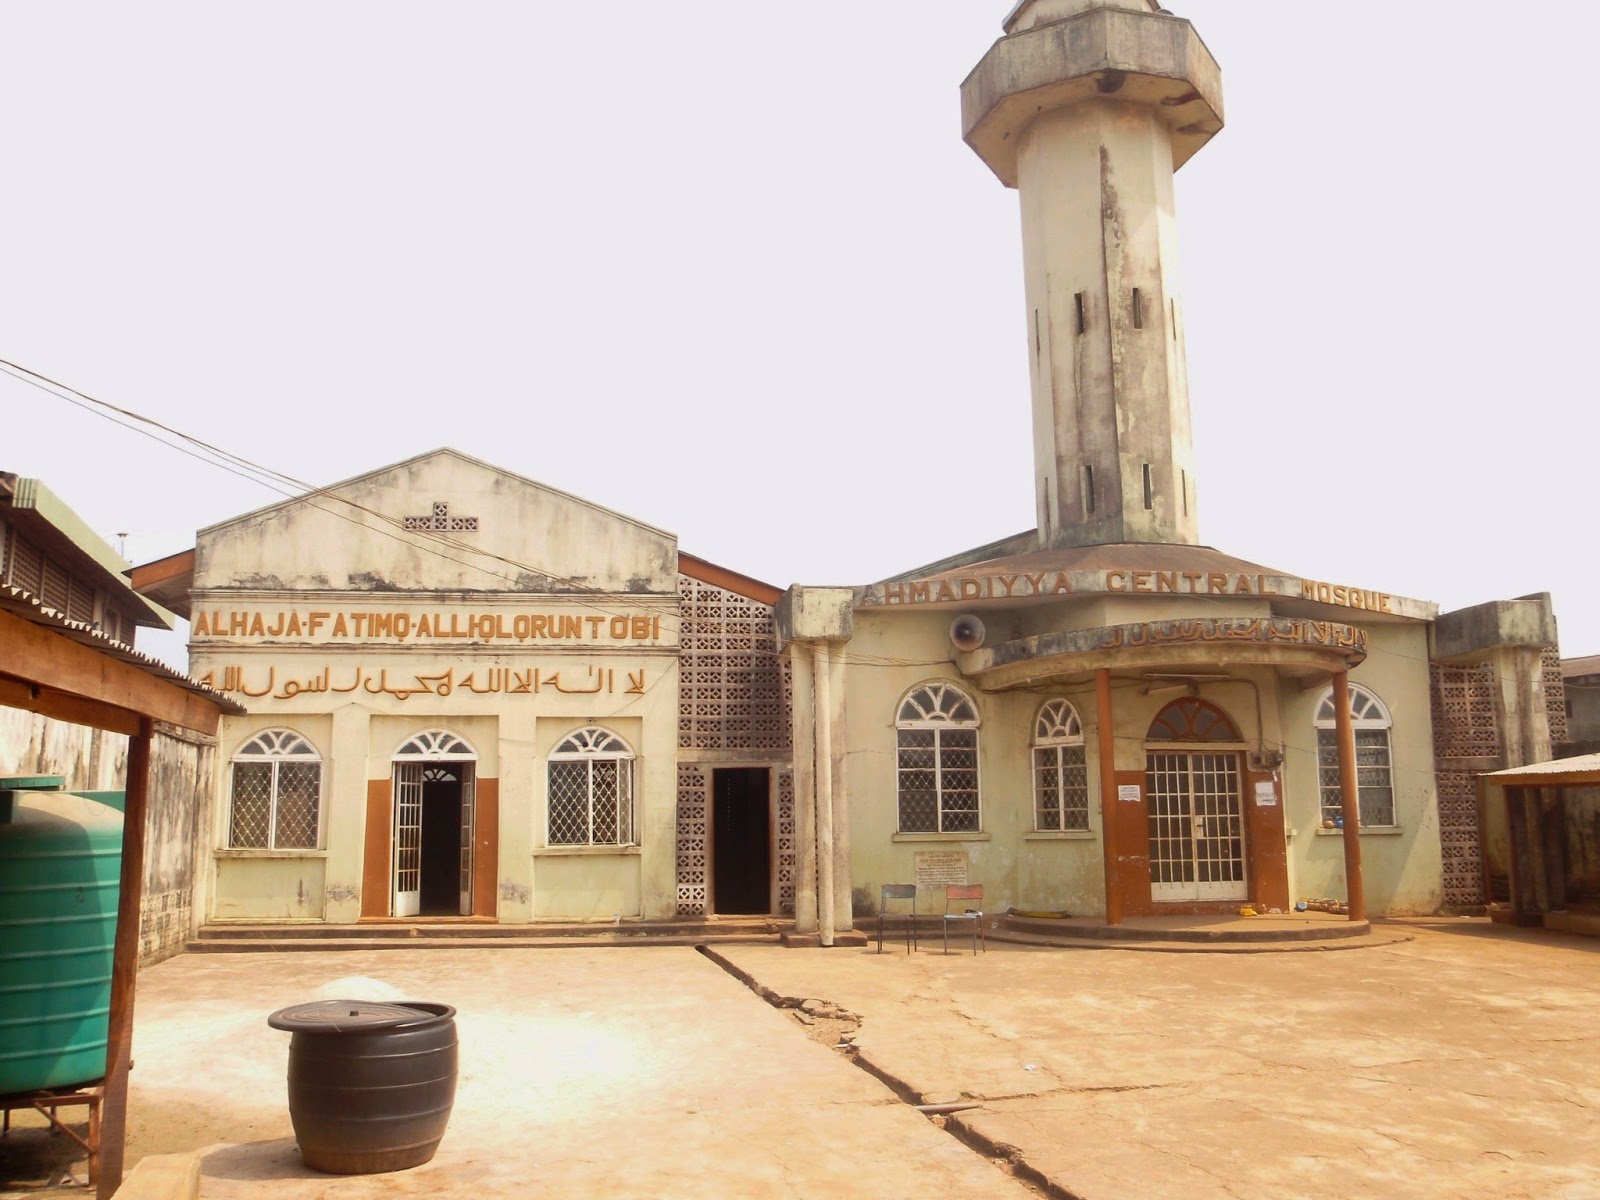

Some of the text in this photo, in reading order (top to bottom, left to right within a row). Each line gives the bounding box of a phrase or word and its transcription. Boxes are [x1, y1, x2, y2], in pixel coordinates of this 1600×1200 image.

[1106, 570, 1277, 597] CENTRAL
[1301, 579, 1392, 613] MOSQUE
[363, 666, 453, 701] محمد
